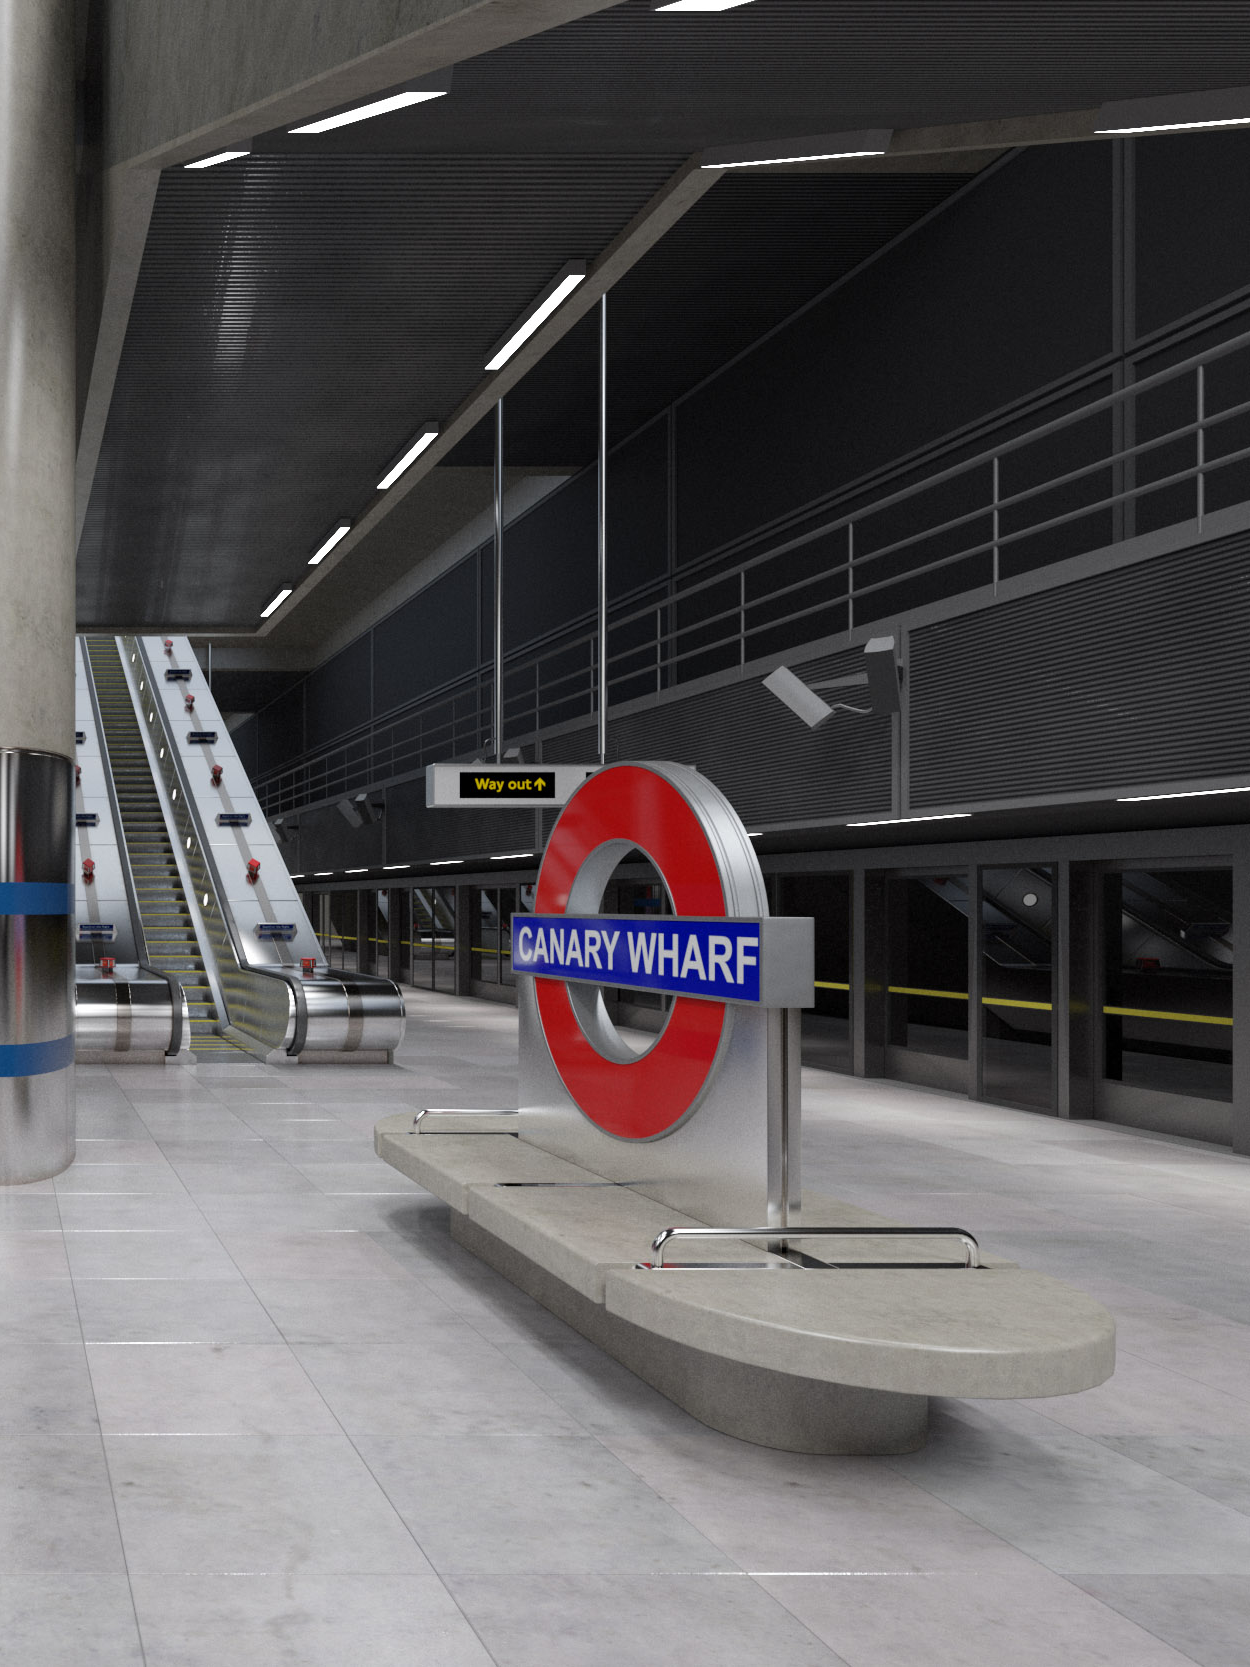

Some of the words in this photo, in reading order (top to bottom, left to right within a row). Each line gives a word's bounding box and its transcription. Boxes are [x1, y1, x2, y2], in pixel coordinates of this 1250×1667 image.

[474, 777, 504, 793] Way
[507, 778, 532, 791] out
[518, 926, 621, 971] CANARY
[627, 931, 759, 985] WHARF
